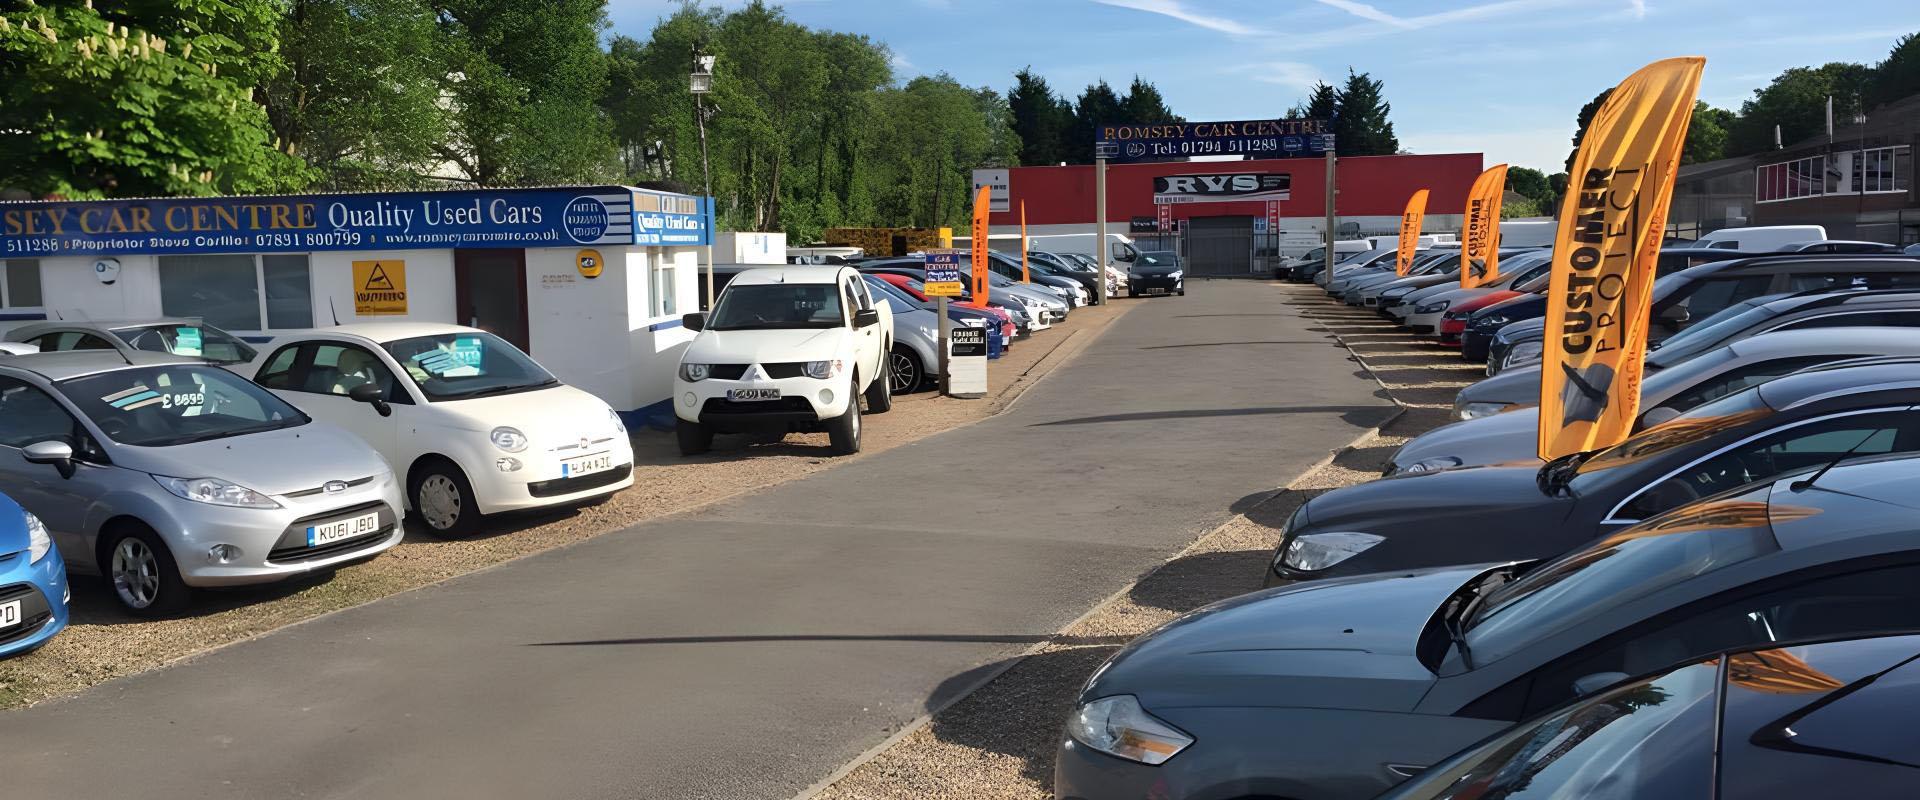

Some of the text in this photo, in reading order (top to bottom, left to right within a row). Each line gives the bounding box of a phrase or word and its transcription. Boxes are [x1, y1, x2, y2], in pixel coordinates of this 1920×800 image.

[1104, 119, 1329, 140] ROMSEY CAR CENTRE
[1150, 141, 1177, 155] Tel:
[1163, 175, 1260, 194] RYS
[0, 198, 543, 235] SEY CAR CENTRE Quality Used Cars
[256, 232, 300, 247] 07891
[306, 231, 361, 246] 800799
